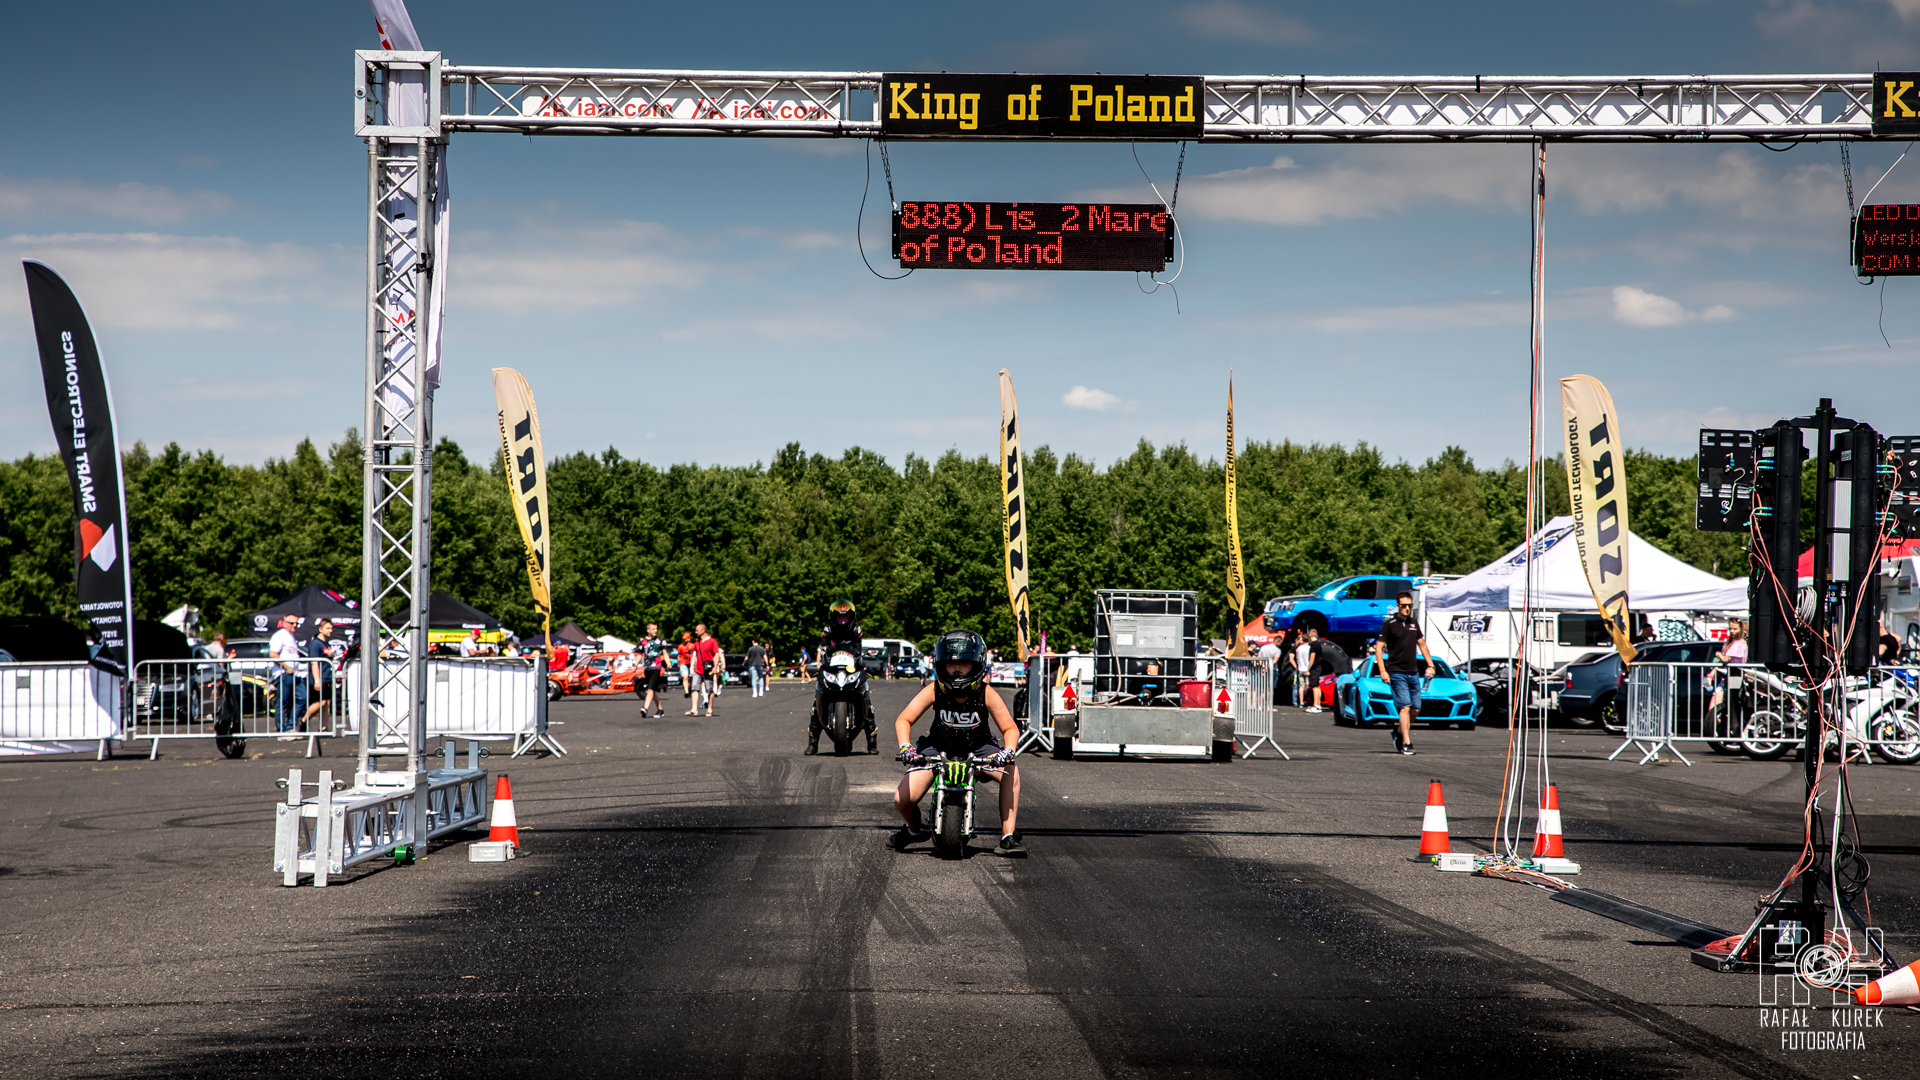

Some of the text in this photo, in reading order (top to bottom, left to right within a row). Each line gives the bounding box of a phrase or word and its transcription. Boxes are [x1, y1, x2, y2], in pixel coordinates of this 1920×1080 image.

[889, 82, 1196, 130] King of Poland
[1883, 81, 1920, 118] K
[1862, 204, 1901, 221] LED
[900, 234, 1063, 264] of Poland
[1862, 254, 1909, 271] COM
[939, 709, 981, 724] NASA
